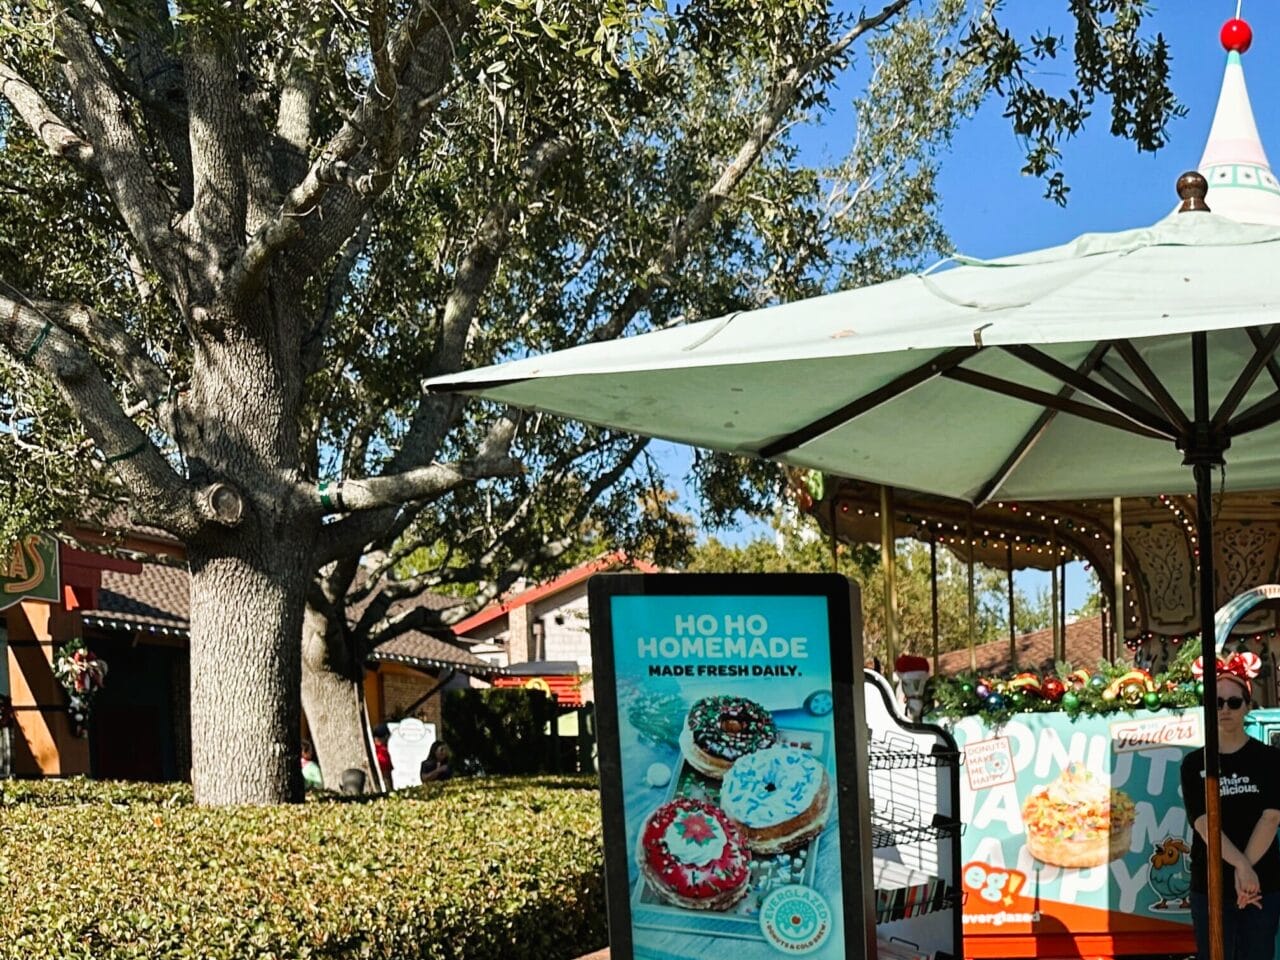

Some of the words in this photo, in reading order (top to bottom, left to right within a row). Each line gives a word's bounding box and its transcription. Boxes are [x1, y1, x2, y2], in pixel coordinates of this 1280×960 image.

[0, 534, 45, 594] AS
[675, 614, 718, 636] HO
[724, 614, 768, 636] HO
[637, 637, 808, 659] HOMEMADE
[648, 665, 694, 677] MADE
[697, 665, 749, 677] FRESH
[752, 664, 802, 677] DAILY.
[1117, 724, 1194, 748] Tenders
[1220, 784, 1260, 797] licious.
[765, 888, 828, 920] EVERGLAZED
[767, 924, 789, 948] DONUTS
